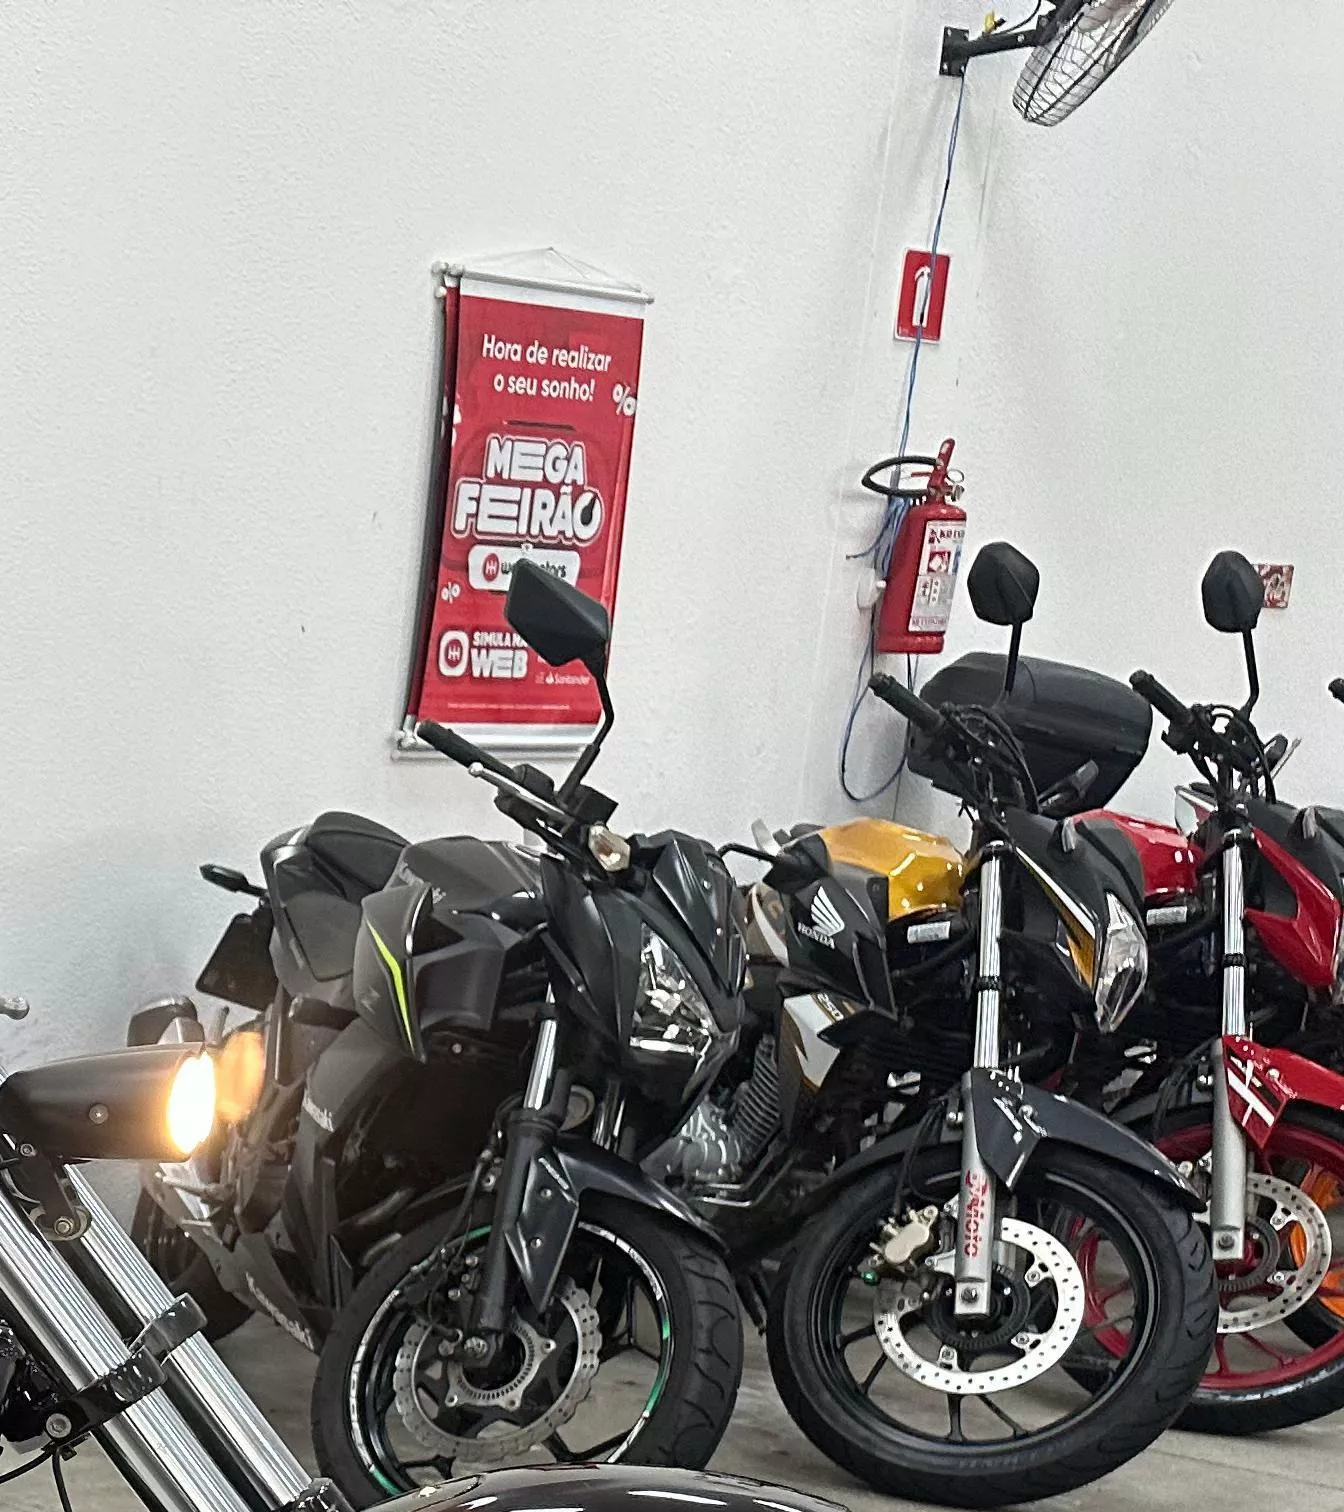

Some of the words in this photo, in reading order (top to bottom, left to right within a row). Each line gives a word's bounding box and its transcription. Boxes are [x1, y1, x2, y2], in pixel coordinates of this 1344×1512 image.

[482, 333, 522, 362] Hora
[526, 340, 549, 365] de
[552, 345, 611, 372] realizar
[493, 373, 505, 393] o
[507, 376, 538, 396] seu
[541, 376, 595, 402] sonho!
[486, 437, 585, 485] MEGA
[454, 483, 603, 541] FEIRÃO
[473, 631, 511, 648] SIMULA
[470, 647, 529, 679] WEB
[797, 921, 836, 950] HONDA
